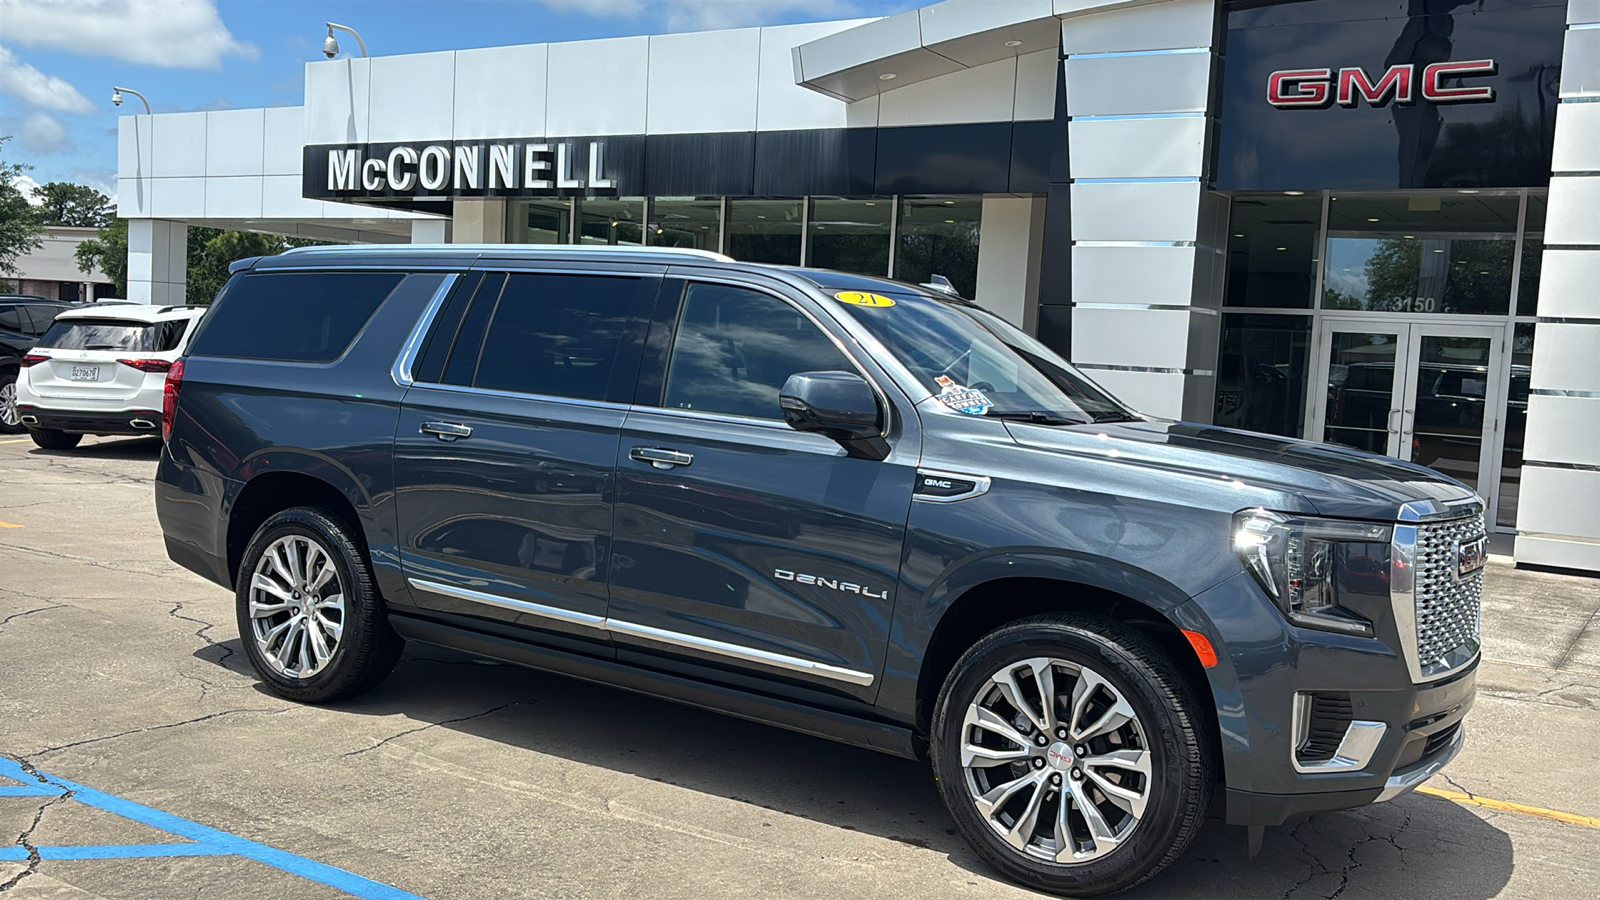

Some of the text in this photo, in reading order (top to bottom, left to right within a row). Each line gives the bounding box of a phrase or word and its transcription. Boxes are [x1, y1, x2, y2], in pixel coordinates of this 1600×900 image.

[1267, 59, 1496, 106] GMC
[327, 142, 616, 191] McCONNELL
[853, 293, 877, 304] 21
[1393, 297, 1435, 312] 3150
[924, 479, 952, 488] GMC
[774, 568, 888, 600] DENALI
[1049, 750, 1072, 763] GMC
